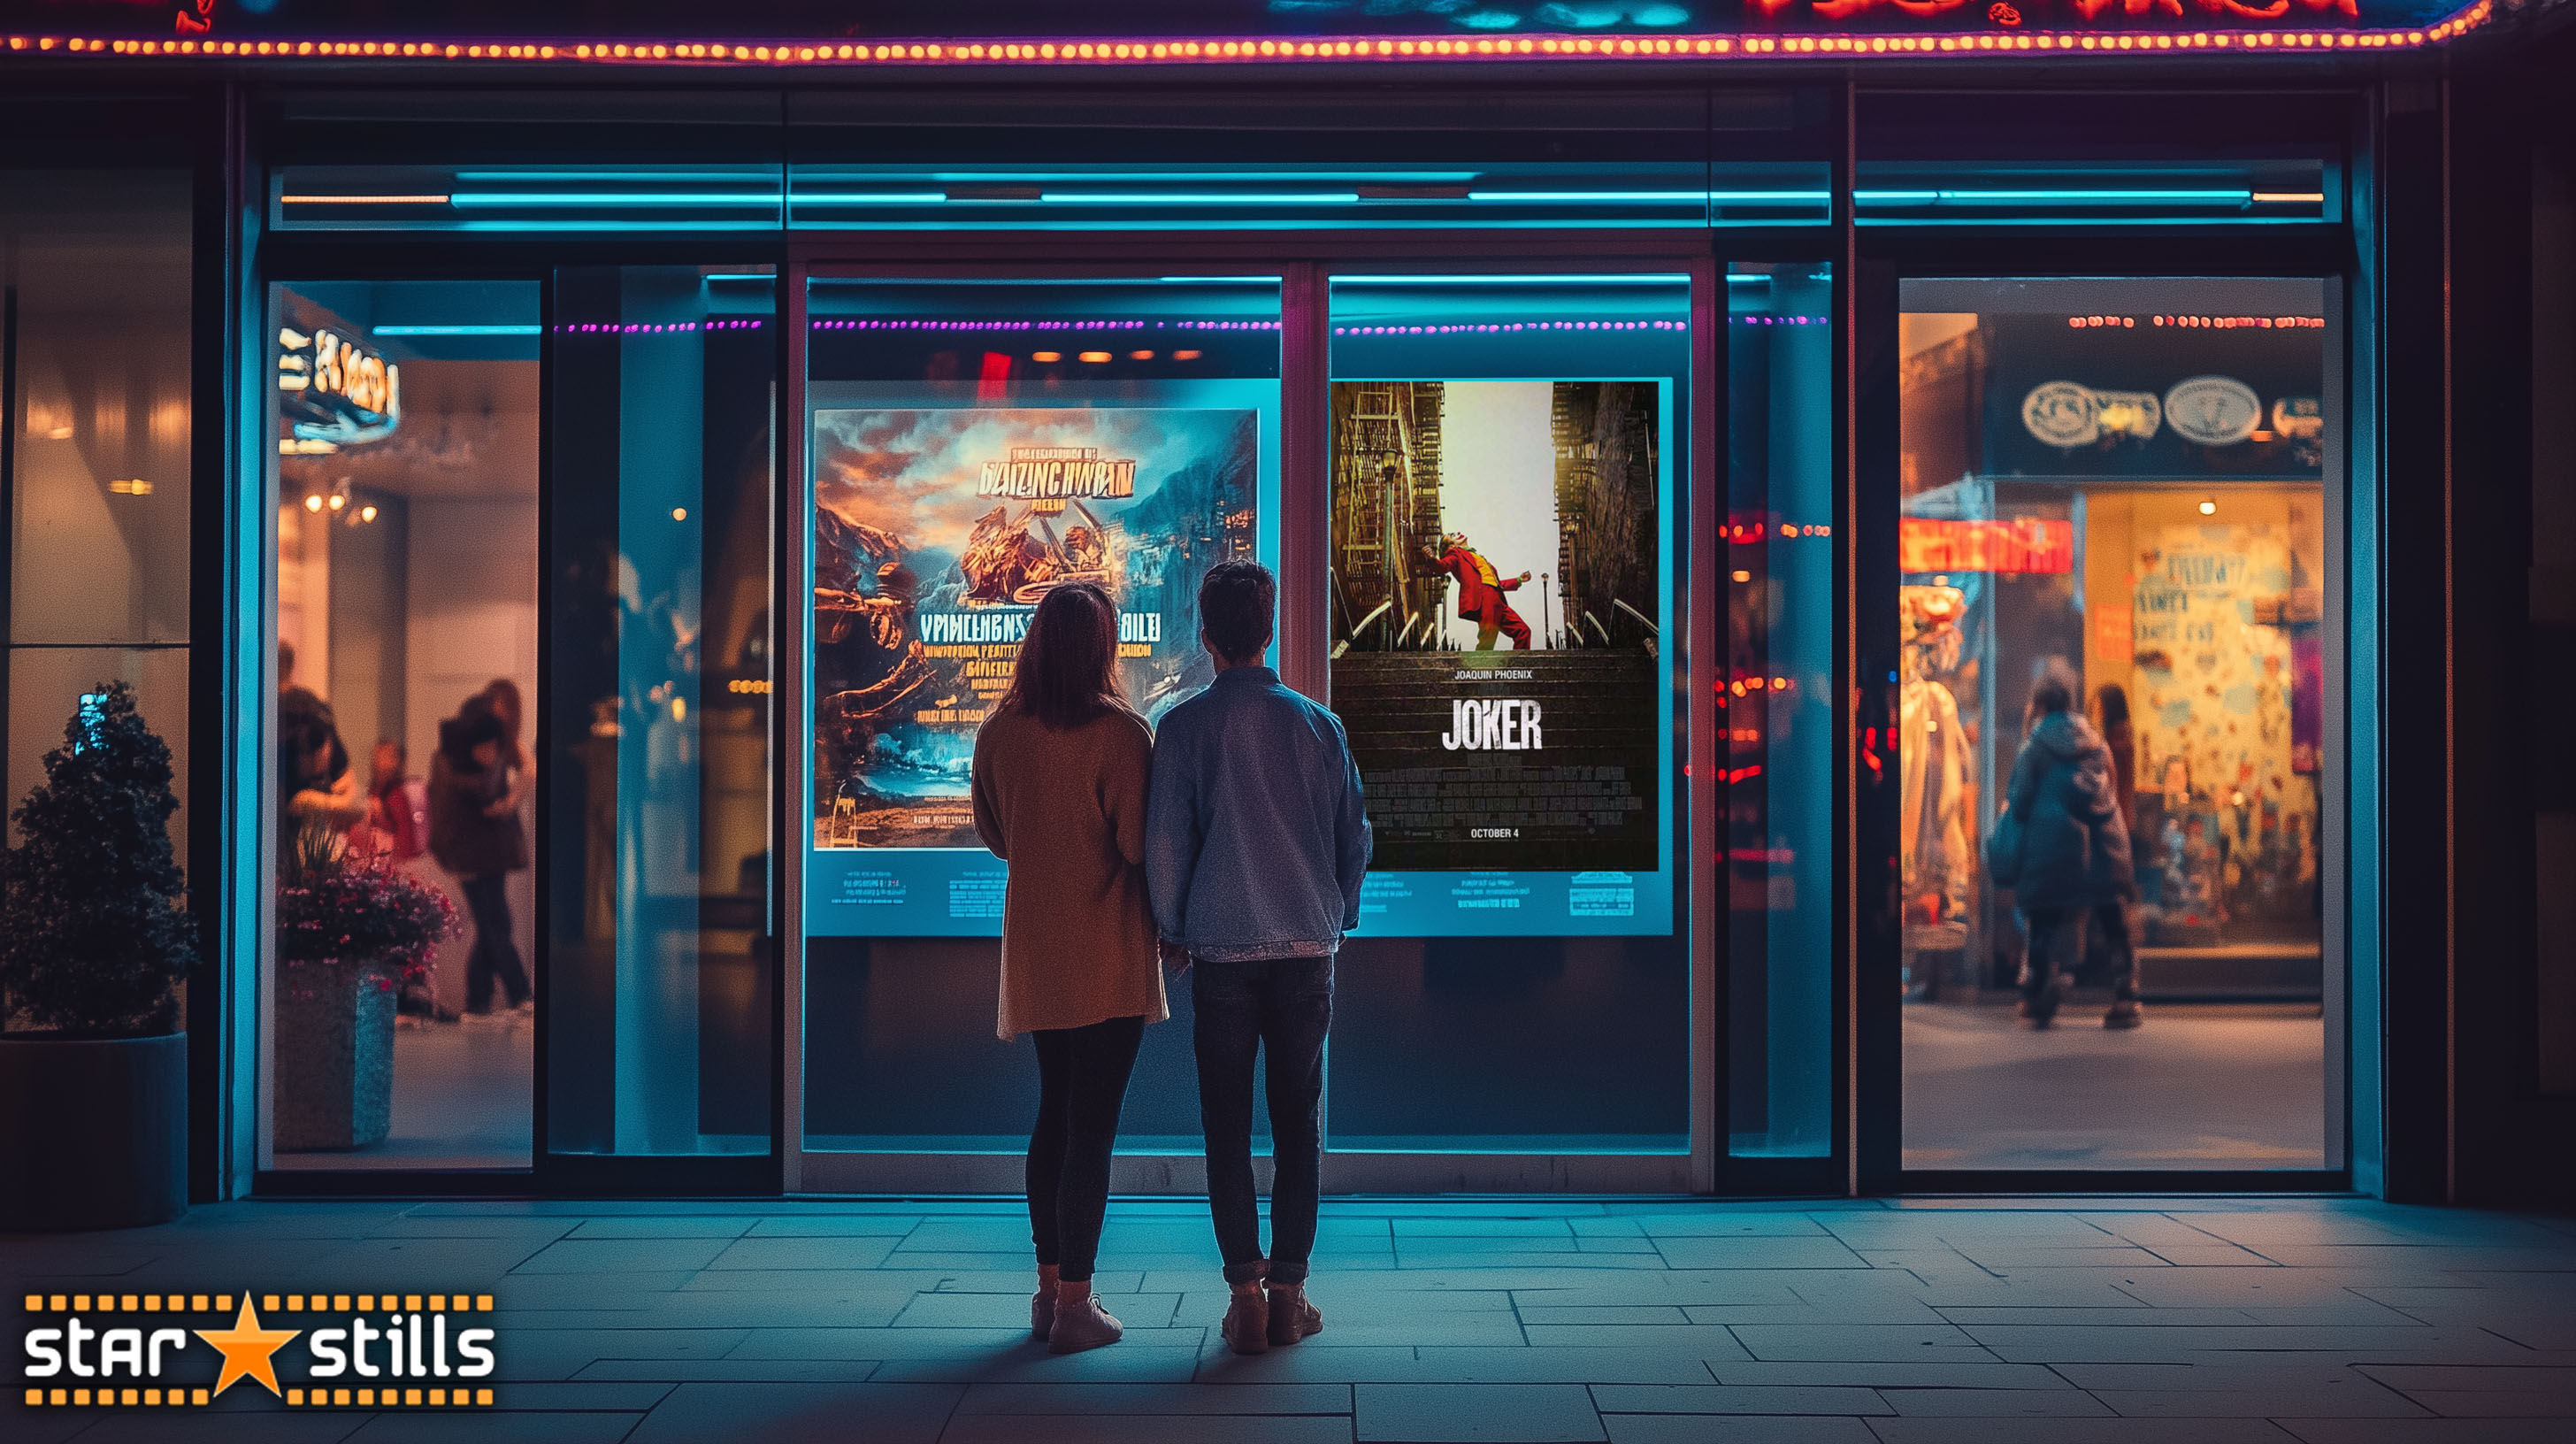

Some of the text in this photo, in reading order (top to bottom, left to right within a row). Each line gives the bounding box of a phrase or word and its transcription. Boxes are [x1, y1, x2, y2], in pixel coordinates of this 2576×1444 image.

[1455, 670, 1532, 680] JOAQUIN PHOENIX
[1442, 699, 1543, 750] JOKER
[1470, 828, 1511, 838] OCTOBER
[1513, 828, 1519, 838] 4
